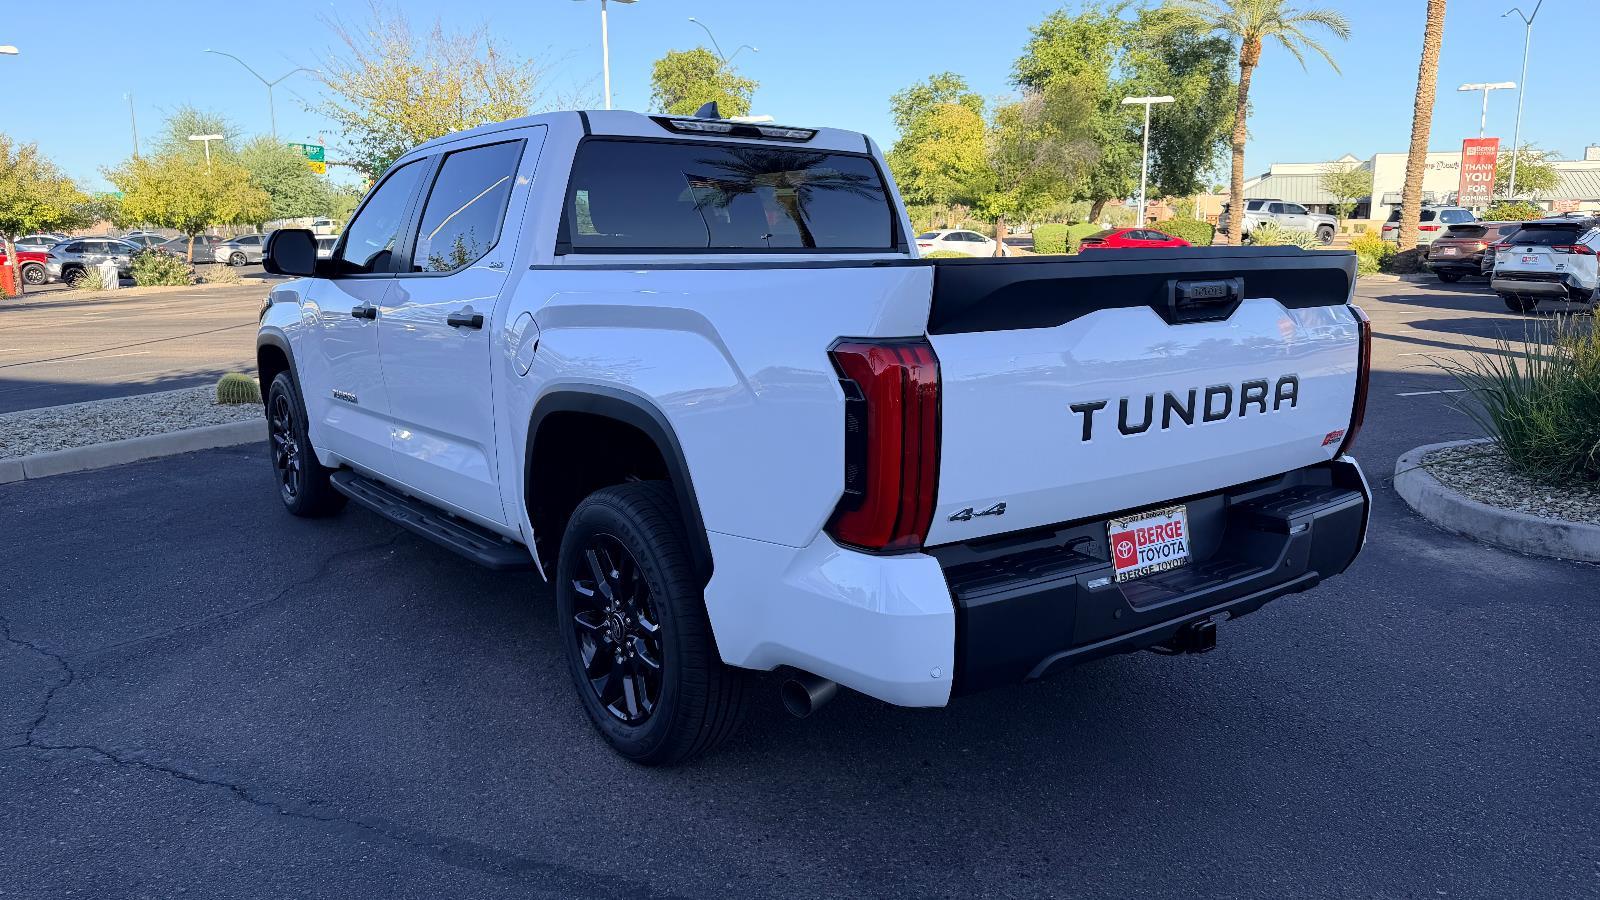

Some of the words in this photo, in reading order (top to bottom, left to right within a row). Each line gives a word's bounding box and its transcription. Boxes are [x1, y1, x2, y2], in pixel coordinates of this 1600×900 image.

[1465, 163, 1493, 171] THANK
[1465, 172, 1492, 182] YOU
[1467, 185, 1487, 193] FOR
[1069, 374, 1299, 442] TUNDRA
[1136, 520, 1183, 546] BERGE
[1139, 541, 1185, 563] TOYOTA
[1119, 564, 1156, 581] BERGE
[1158, 556, 1188, 571] TOYOTA
